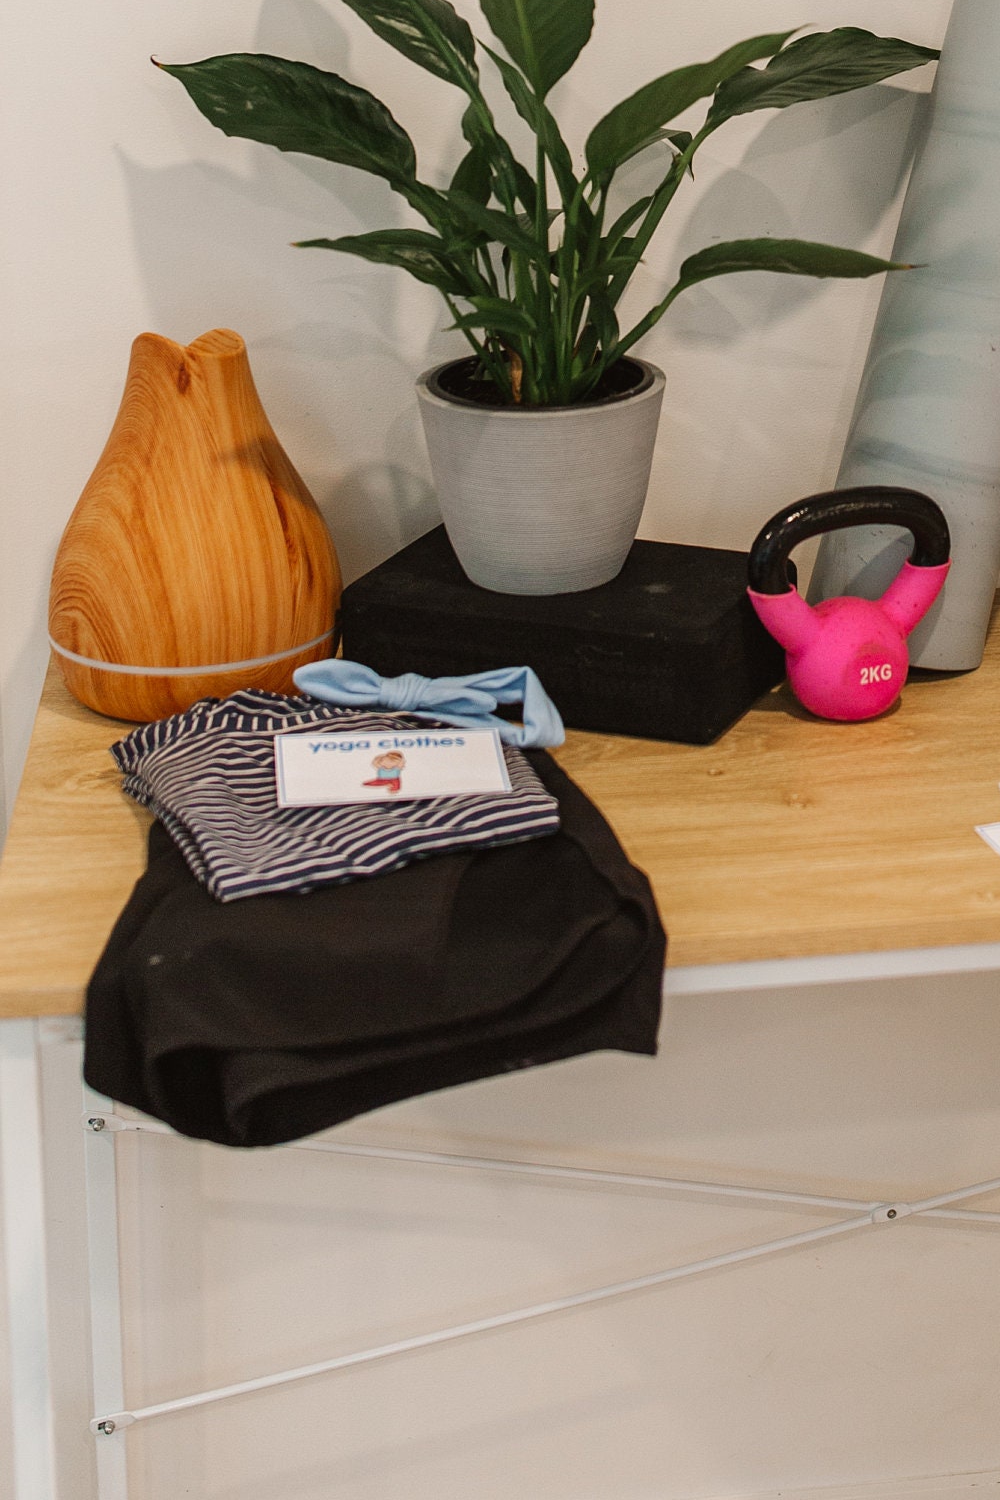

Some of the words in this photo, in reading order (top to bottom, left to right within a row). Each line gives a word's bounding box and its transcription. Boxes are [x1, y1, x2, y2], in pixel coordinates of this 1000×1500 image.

[860, 664, 892, 685] 2KG
[309, 738, 370, 754] yoga
[378, 735, 466, 750] clothes
